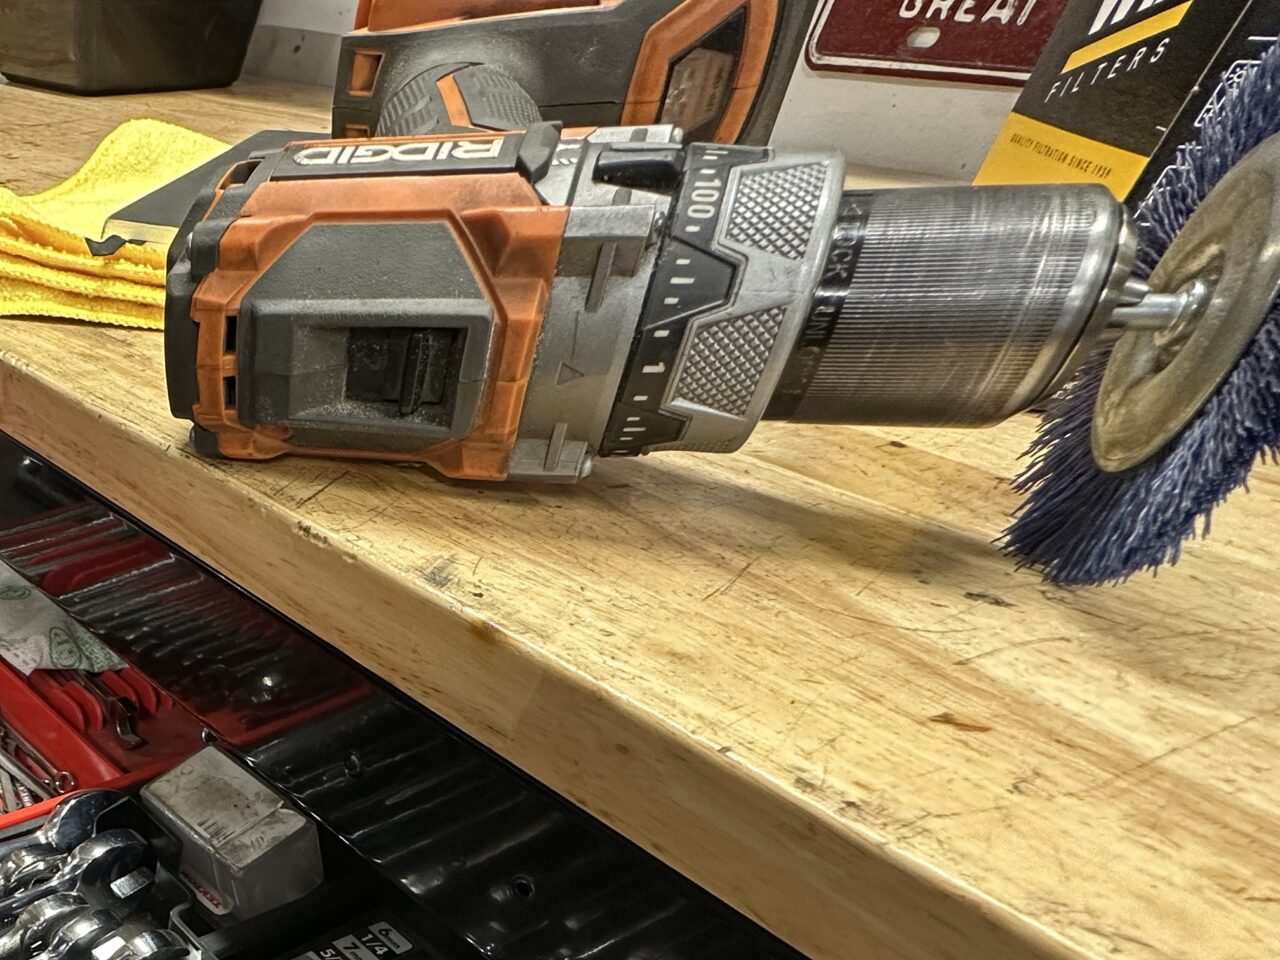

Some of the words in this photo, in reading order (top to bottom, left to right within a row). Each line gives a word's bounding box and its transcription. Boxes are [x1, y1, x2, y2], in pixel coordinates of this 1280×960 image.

[1044, 37, 1170, 103] FILTERS
[293, 137, 506, 166] RIDGID
[1010, 133, 1034, 149] QUALITY
[1032, 141, 1069, 163] FILTRATION
[1067, 155, 1093, 172] SINCE
[1090, 164, 1112, 179] 1939
[686, 178, 722, 219] 100
[361, 933, 389, 955] 1/4
